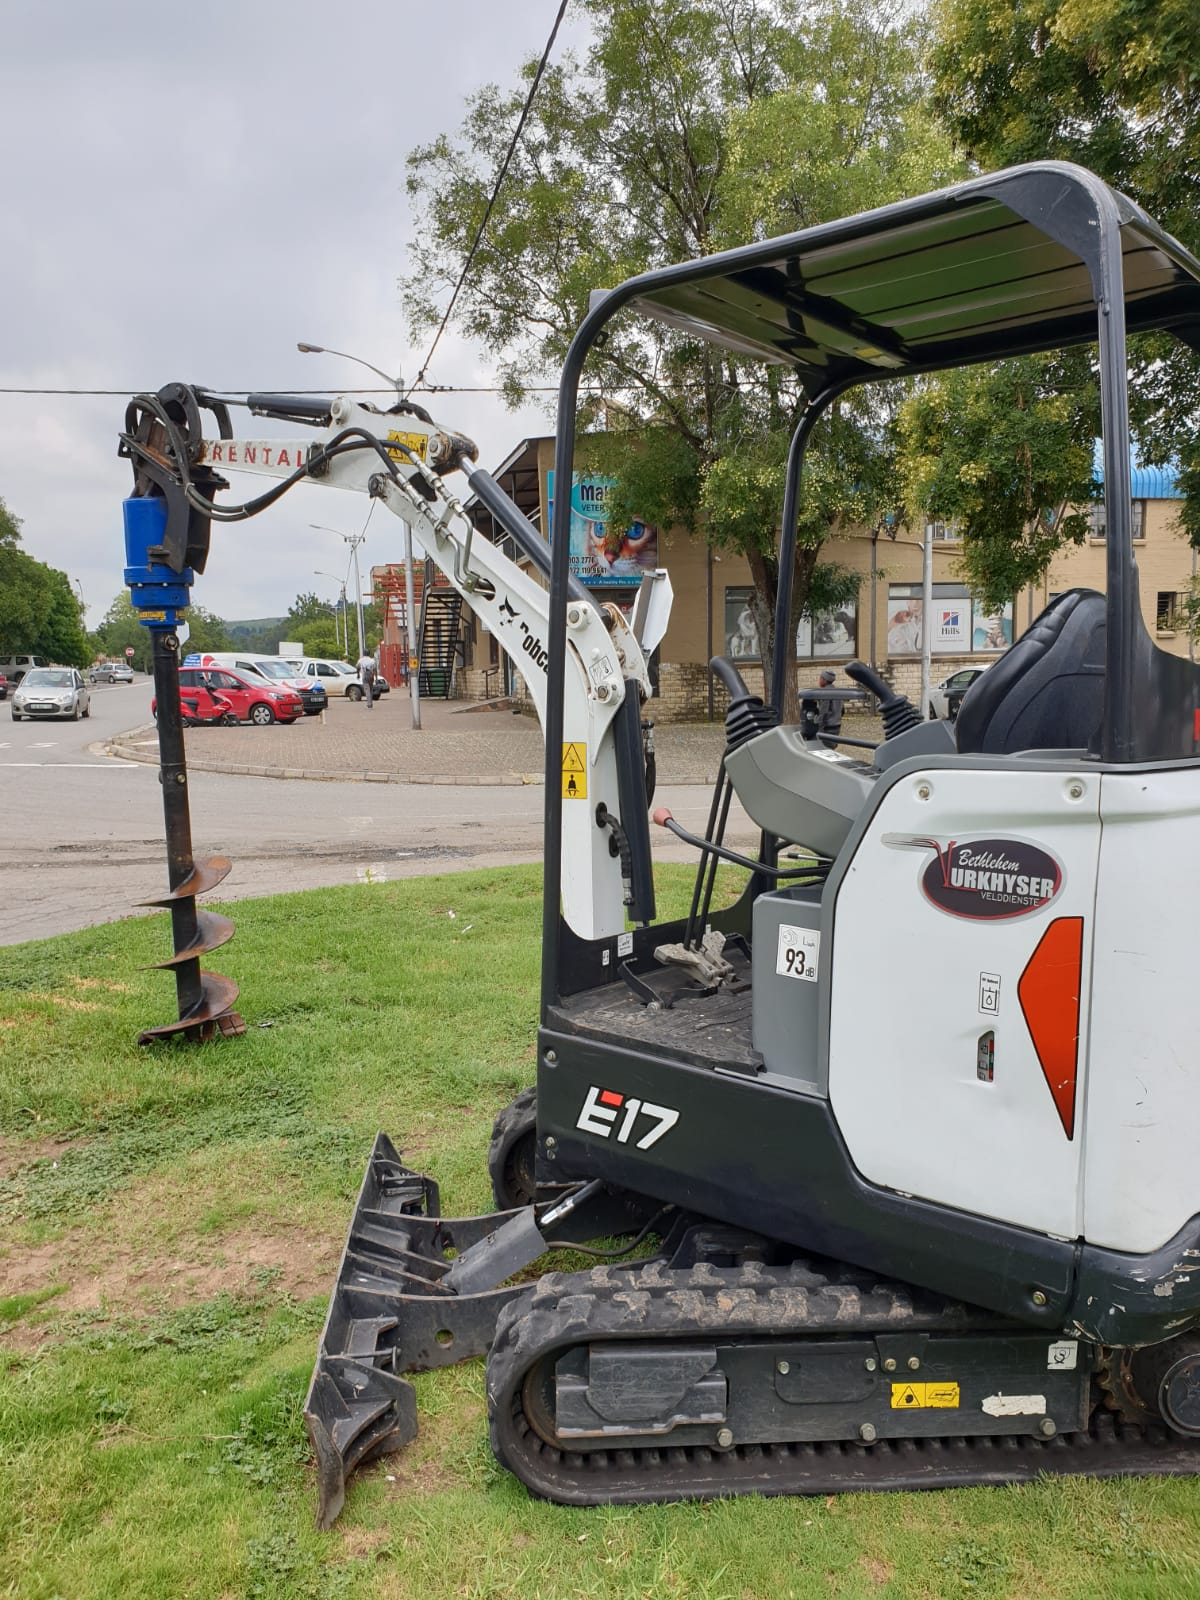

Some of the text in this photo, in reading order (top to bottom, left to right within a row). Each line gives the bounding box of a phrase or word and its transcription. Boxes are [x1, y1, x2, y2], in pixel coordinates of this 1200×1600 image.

[212, 445, 305, 467] RENTAL
[581, 504, 605, 512] VETER
[958, 849, 1020, 871] Bethlehem
[980, 891, 1040, 907] VELDDIENSTE
[786, 948, 815, 977] 93 dB
[576, 1086, 680, 1150] E17
